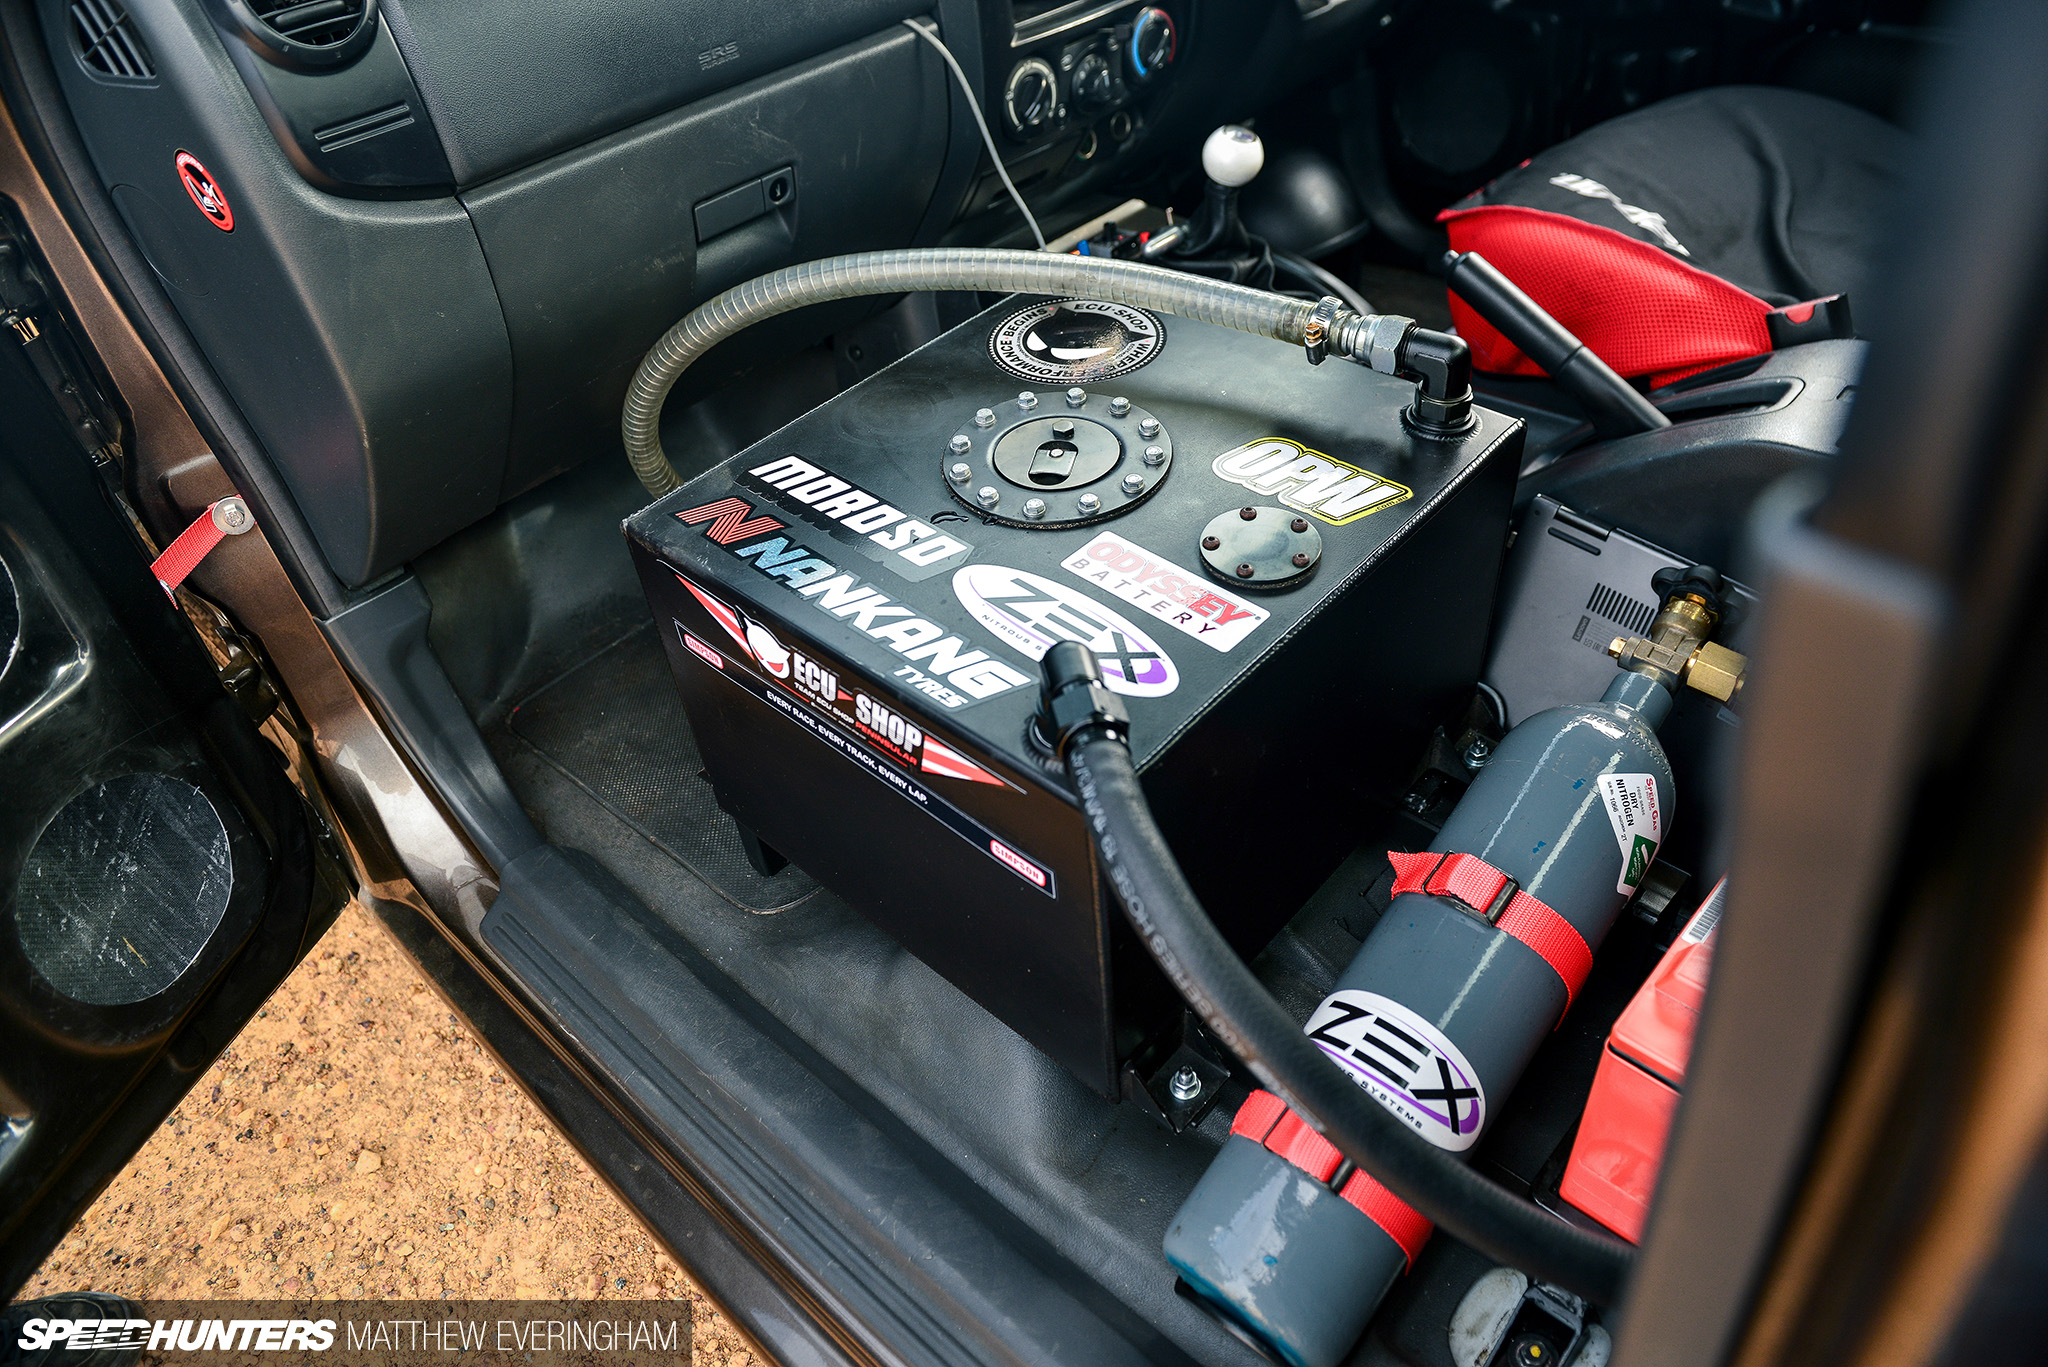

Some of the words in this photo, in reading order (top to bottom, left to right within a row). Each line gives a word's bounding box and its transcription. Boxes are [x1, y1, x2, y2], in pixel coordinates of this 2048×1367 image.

[698, 41, 738, 64] SRS
[1003, 307, 1048, 338] BEGINS
[1073, 302, 1113, 313] ECU
[1117, 309, 1149, 332] SHOP
[748, 455, 968, 568] MOROSO
[1221, 441, 1404, 520] OPW
[735, 536, 1031, 699] NANKANG
[1070, 557, 1218, 636] BATTERY
[1086, 541, 1255, 626] ODYSSEY
[686, 635, 721, 665] SIMPSON
[982, 577, 1162, 685] ZEX
[793, 652, 837, 702] ECU
[855, 693, 922, 754] SHOP
[794, 681, 816, 700] TEAM
[815, 696, 832, 710] ECU
[832, 707, 855, 725] SHOP
[855, 720, 918, 766] PENINSULAR
[893, 665, 969, 709] TYRES
[766, 690, 792, 712] EVERY
[792, 707, 818, 730] RACE.
[818, 724, 845, 749] EVERY
[845, 743, 878, 770] TRACK.
[878, 765, 908, 790] EVERY
[908, 785, 929, 805] LAP.
[1616, 778, 1635, 827] NITROGEN
[1629, 791, 1640, 810] DRY
[994, 844, 1040, 880] SIMPSON
[1110, 864, 1155, 938] HOSE
[1150, 933, 1215, 1018] SERIES
[1308, 1000, 1481, 1136] ZEX
[1360, 1079, 1423, 1130] SYSTEMS
